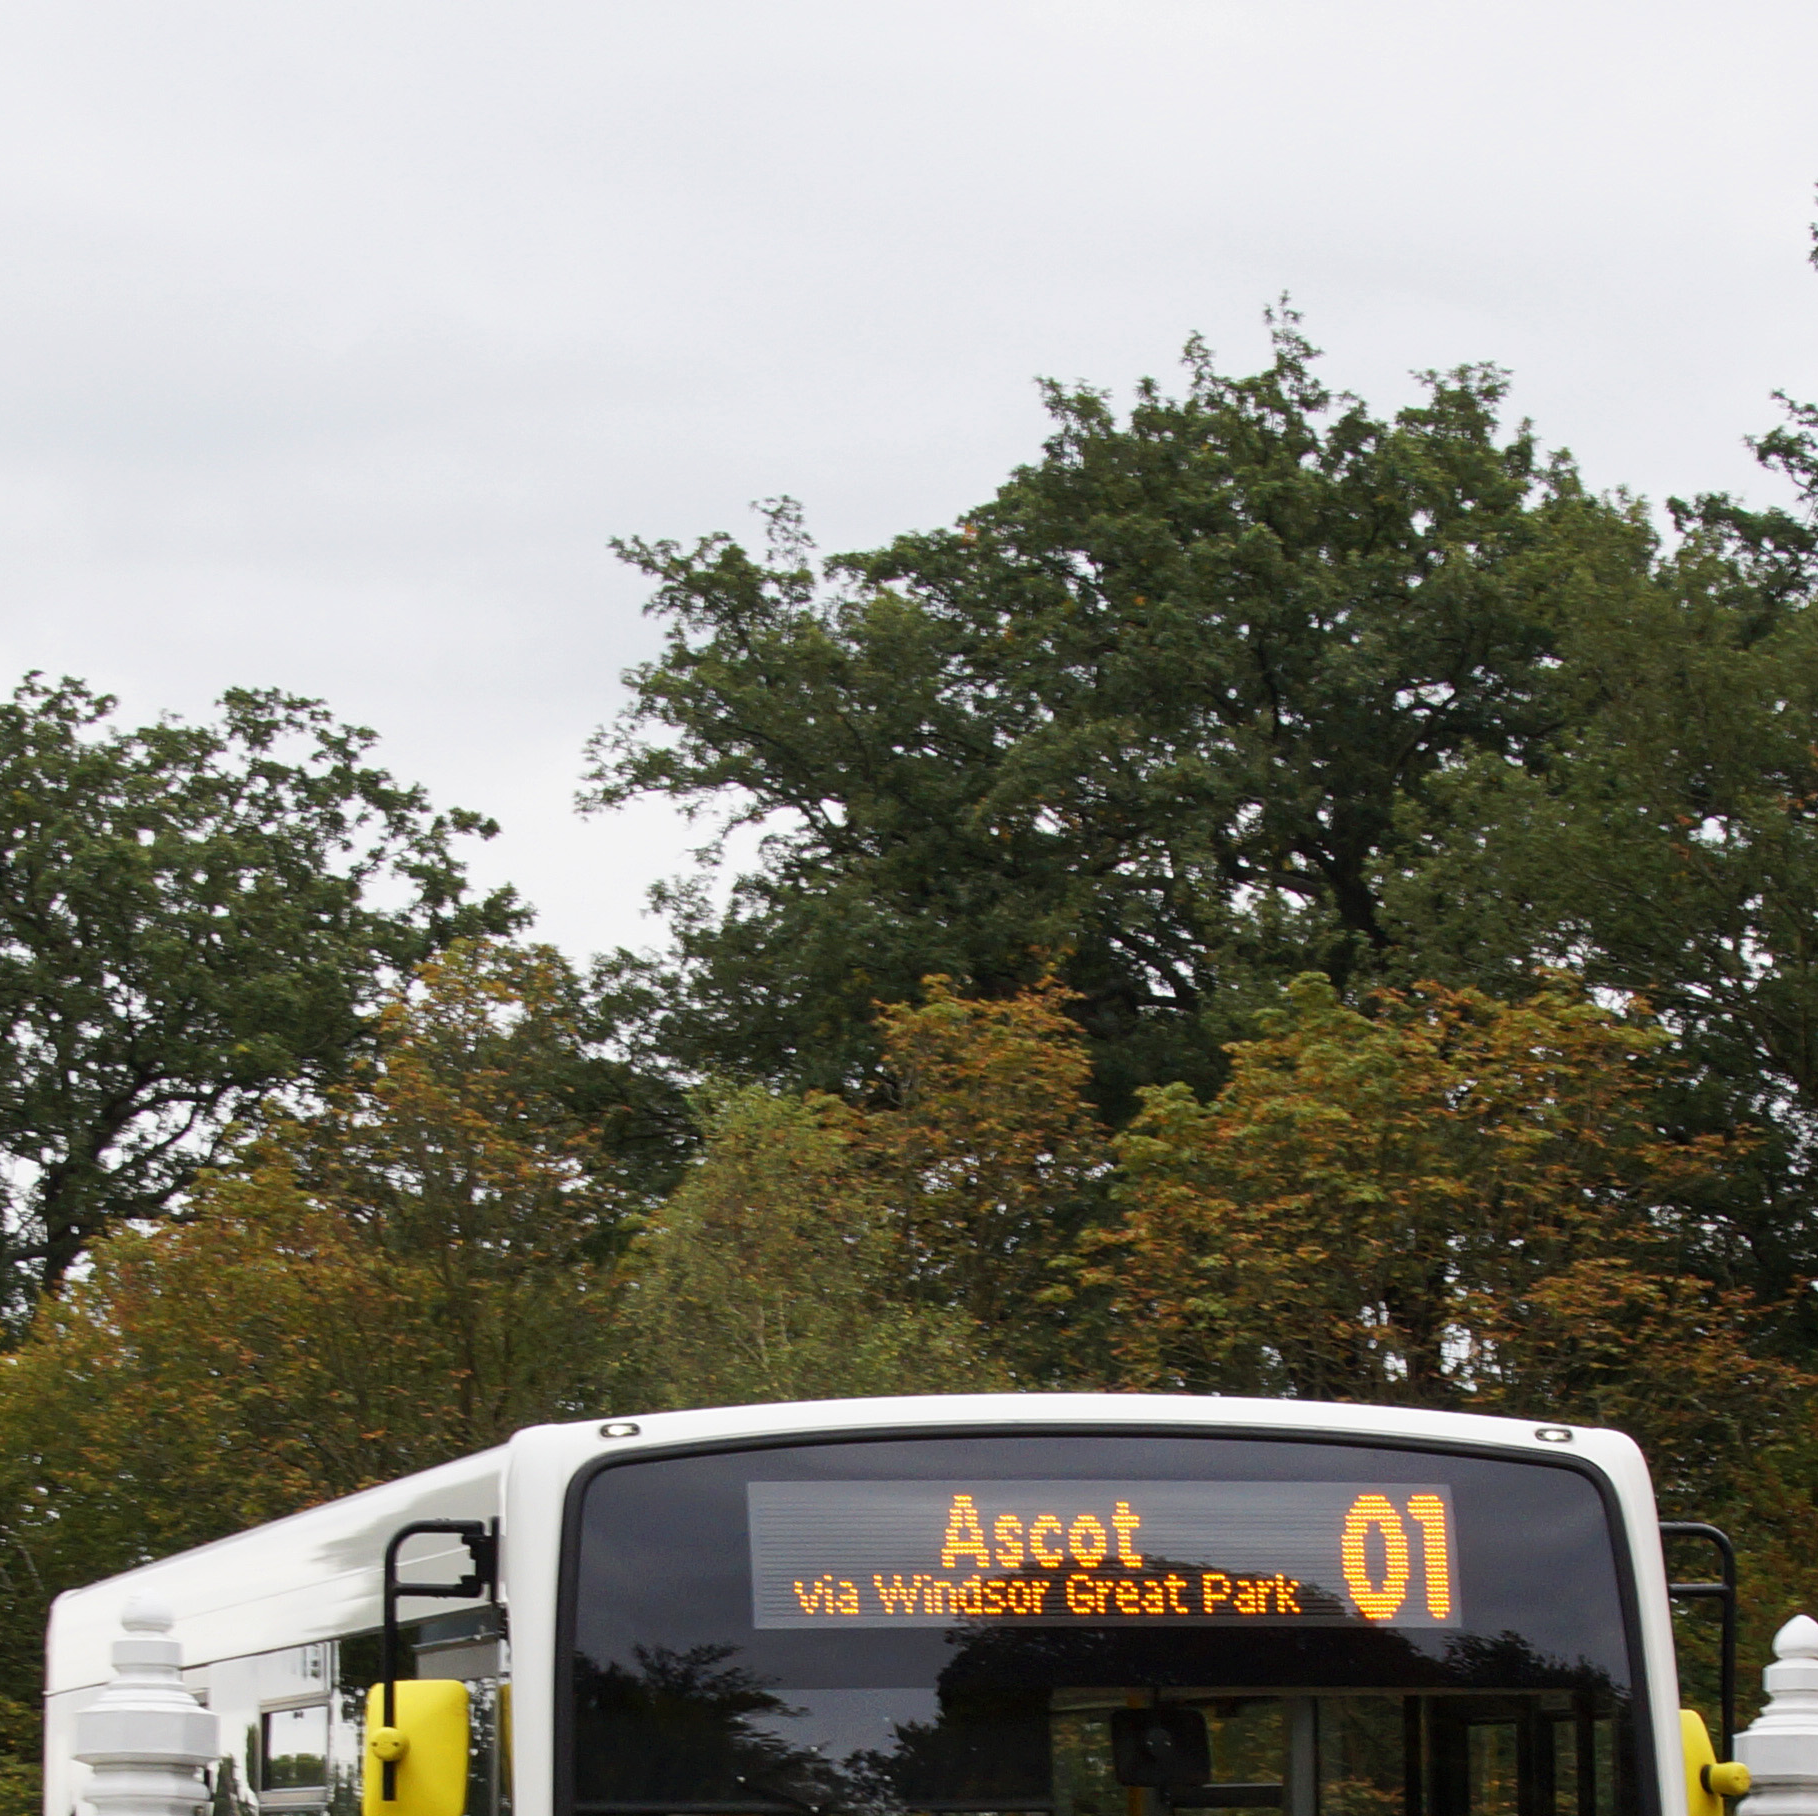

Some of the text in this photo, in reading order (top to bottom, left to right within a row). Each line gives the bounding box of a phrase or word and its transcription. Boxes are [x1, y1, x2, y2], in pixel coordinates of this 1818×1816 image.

[941, 1494, 1142, 1568] Ascot
[1341, 1494, 1451, 1620] 01
[793, 1574, 1301, 1615] via Windsor Great Park
